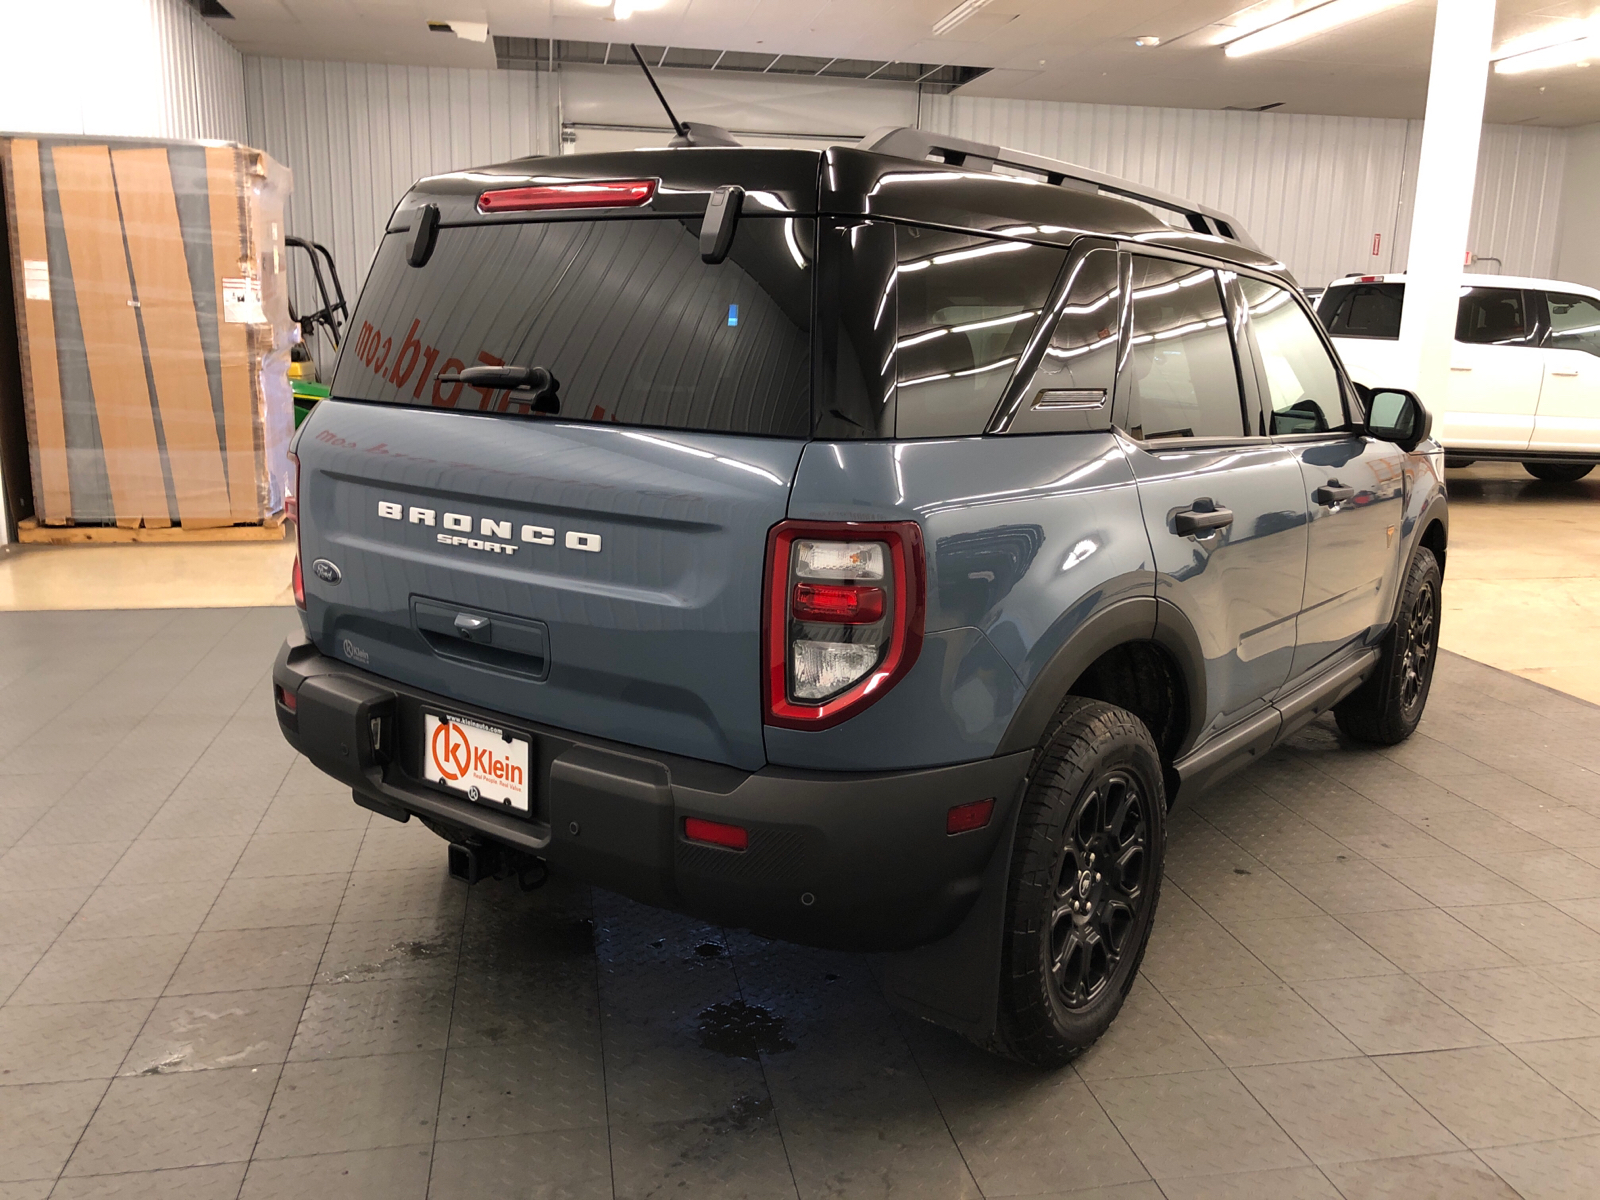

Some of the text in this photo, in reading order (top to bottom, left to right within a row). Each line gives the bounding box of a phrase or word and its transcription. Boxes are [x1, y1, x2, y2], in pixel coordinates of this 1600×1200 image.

[378, 500, 603, 553] BRONCO
[436, 533, 518, 555] SPORT
[446, 715, 503, 735] www.kleinauto.com
[474, 746, 523, 785] Klein
